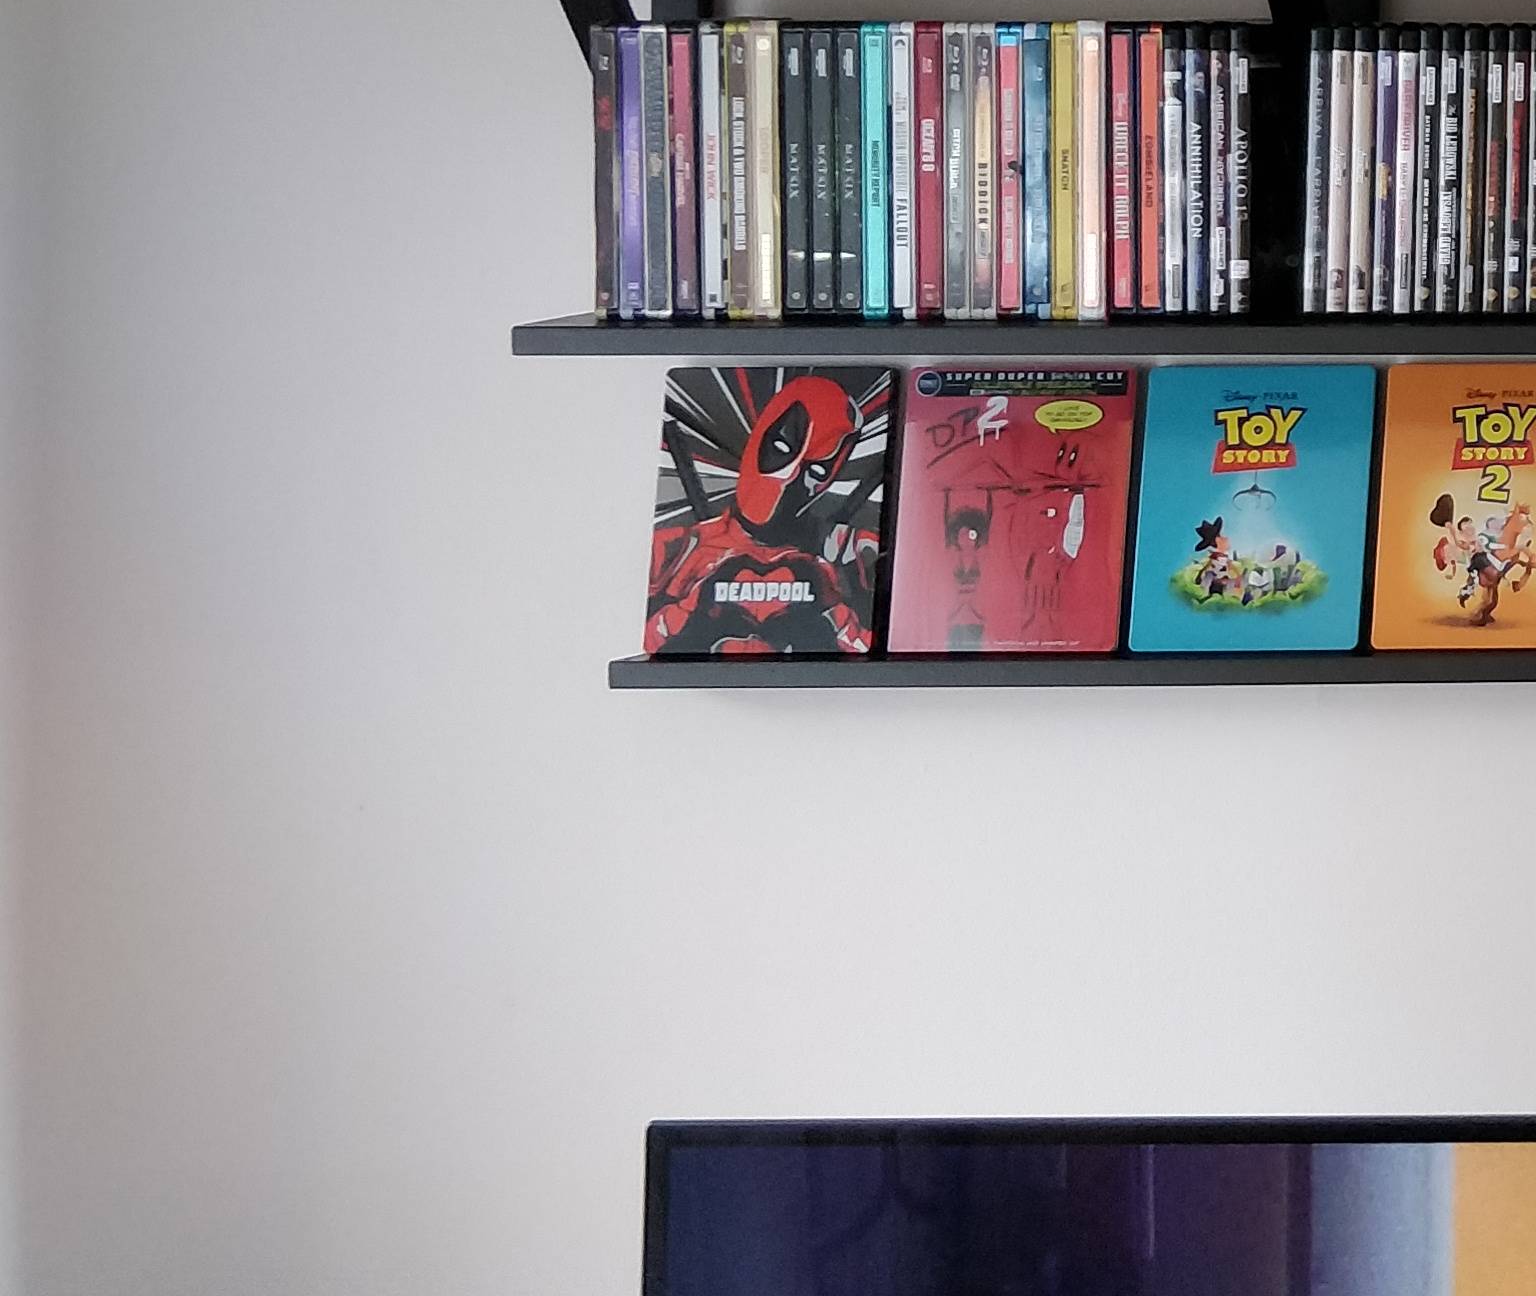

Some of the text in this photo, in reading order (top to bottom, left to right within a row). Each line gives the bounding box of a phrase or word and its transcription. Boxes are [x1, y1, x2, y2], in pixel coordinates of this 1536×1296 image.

[1216, 85, 1224, 150] AMERICAN
[706, 169, 717, 200] WICK
[789, 143, 799, 199] MATRIX
[816, 144, 827, 200] MATRIX
[844, 143, 854, 200] MATRIX
[1061, 148, 1070, 191] SNATCH
[1144, 135, 1154, 208] ZOMBIELAND
[1189, 121, 1203, 239] ANNIHILATION
[1234, 127, 1248, 200] APOLLO
[896, 198, 909, 248] FALLOUT
[946, 372, 1124, 382] SUPER DUPER CUT
[978, 396, 1008, 446] 2
[1215, 405, 1308, 448] TOY
[1222, 448, 1290, 464] STORY
[1461, 446, 1528, 462] STORY
[1477, 464, 1511, 503] 2
[714, 581, 815, 602] DEADPOOL
